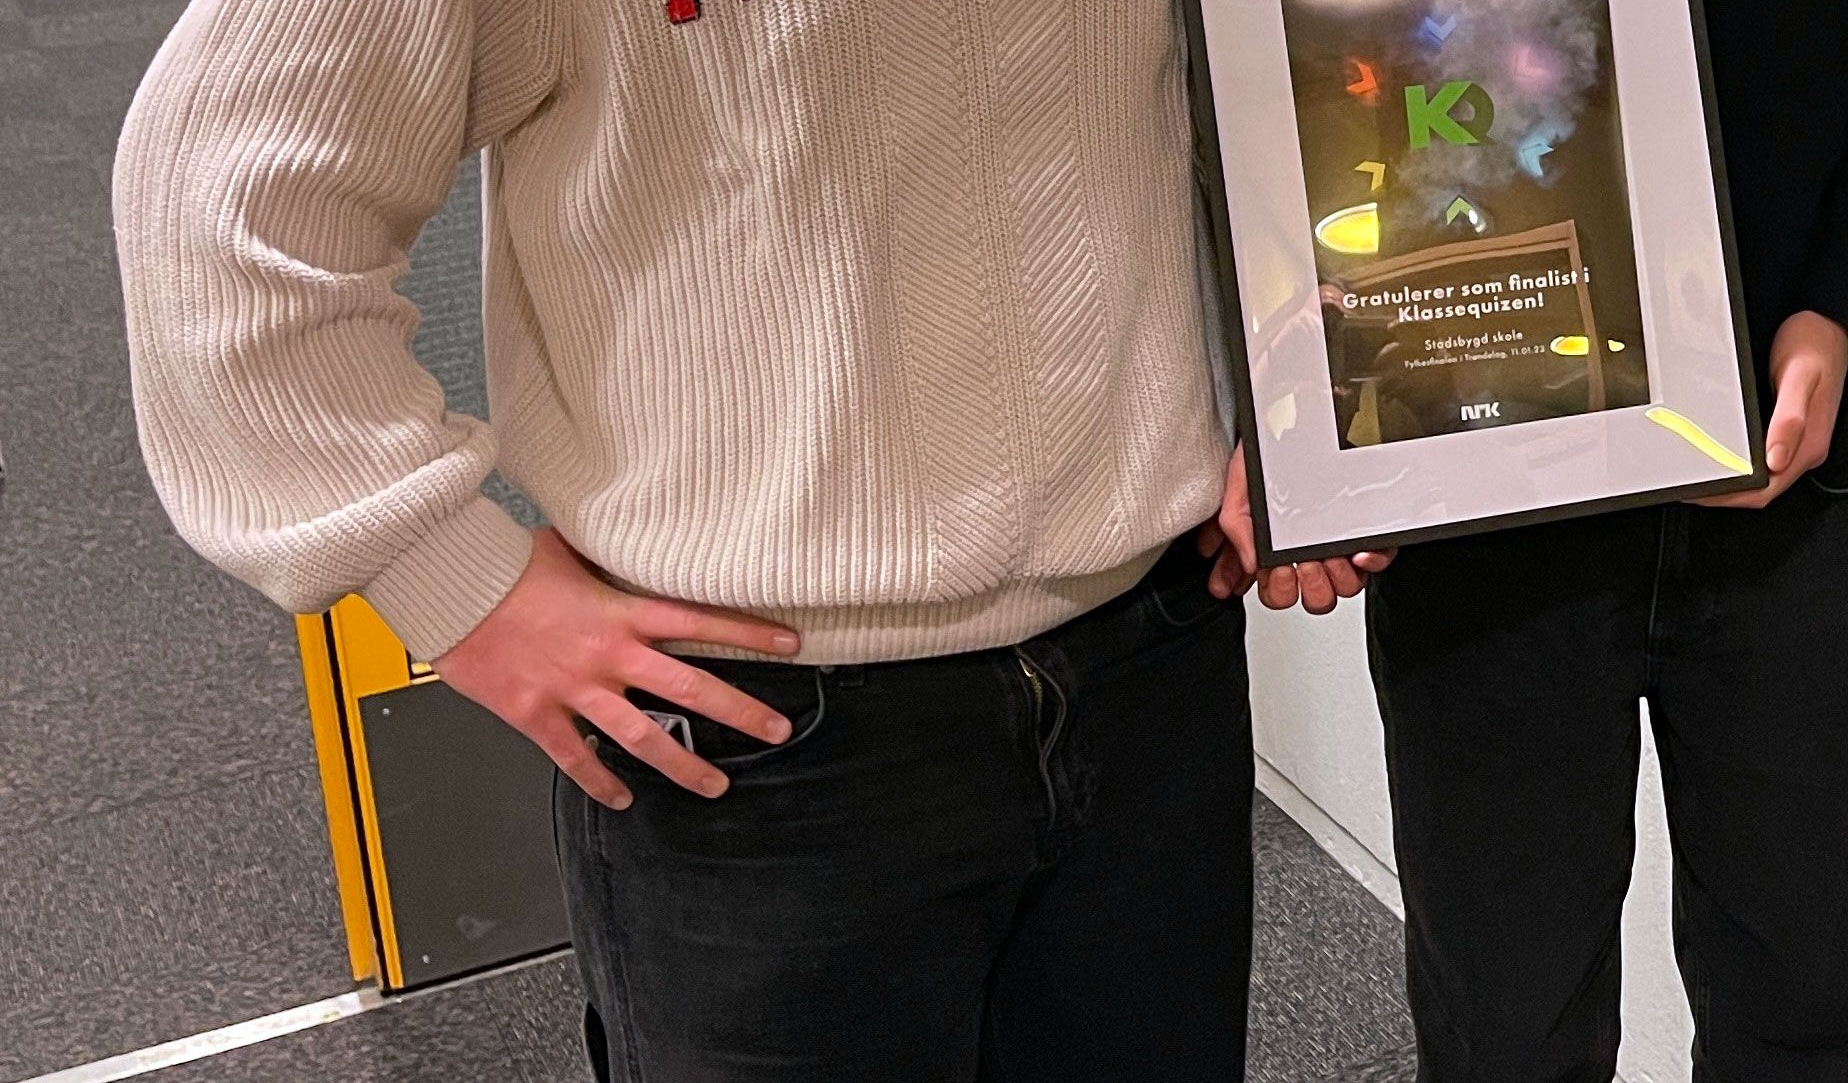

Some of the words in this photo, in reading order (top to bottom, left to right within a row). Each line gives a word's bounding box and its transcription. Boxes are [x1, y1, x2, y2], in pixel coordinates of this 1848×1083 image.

[1342, 285, 1455, 310] Gratulerer
[1461, 282, 1503, 297] som
[1508, 269, 1578, 292] finalist
[1583, 266, 1591, 284] i
[1398, 292, 1545, 323] Klassequizen!
[1424, 332, 1489, 352] Stadsbygd
[1492, 329, 1524, 343] skole
[1459, 400, 1501, 422] NRK
